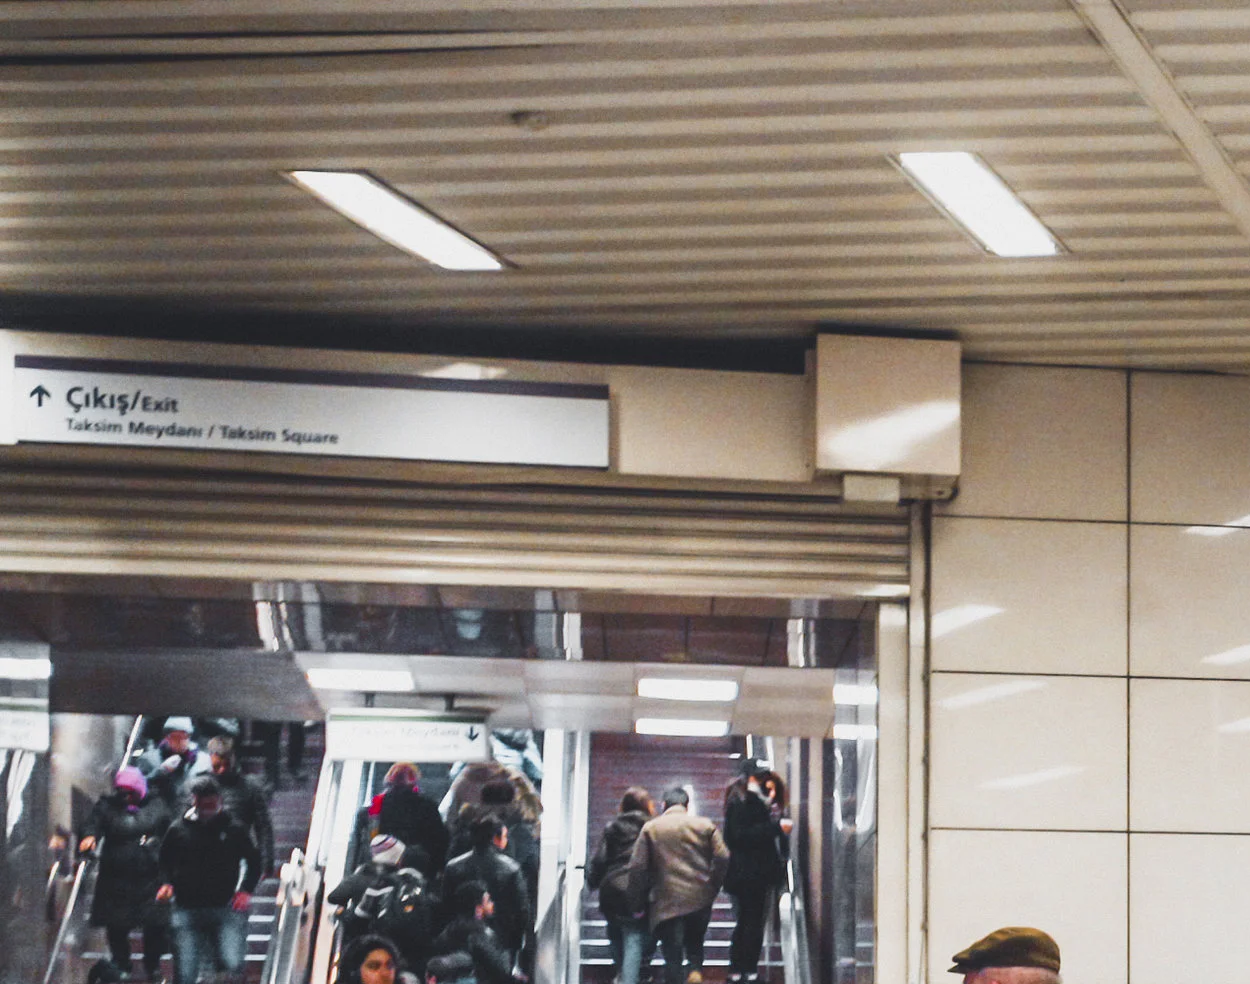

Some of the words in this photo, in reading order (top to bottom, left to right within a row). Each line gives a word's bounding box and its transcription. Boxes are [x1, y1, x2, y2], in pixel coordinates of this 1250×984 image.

[66, 418, 123, 434] Taksim
[127, 421, 203, 440] Meydanı
[207, 424, 216, 439] /
[219, 425, 277, 443] Taksim
[281, 429, 339, 446] Square
